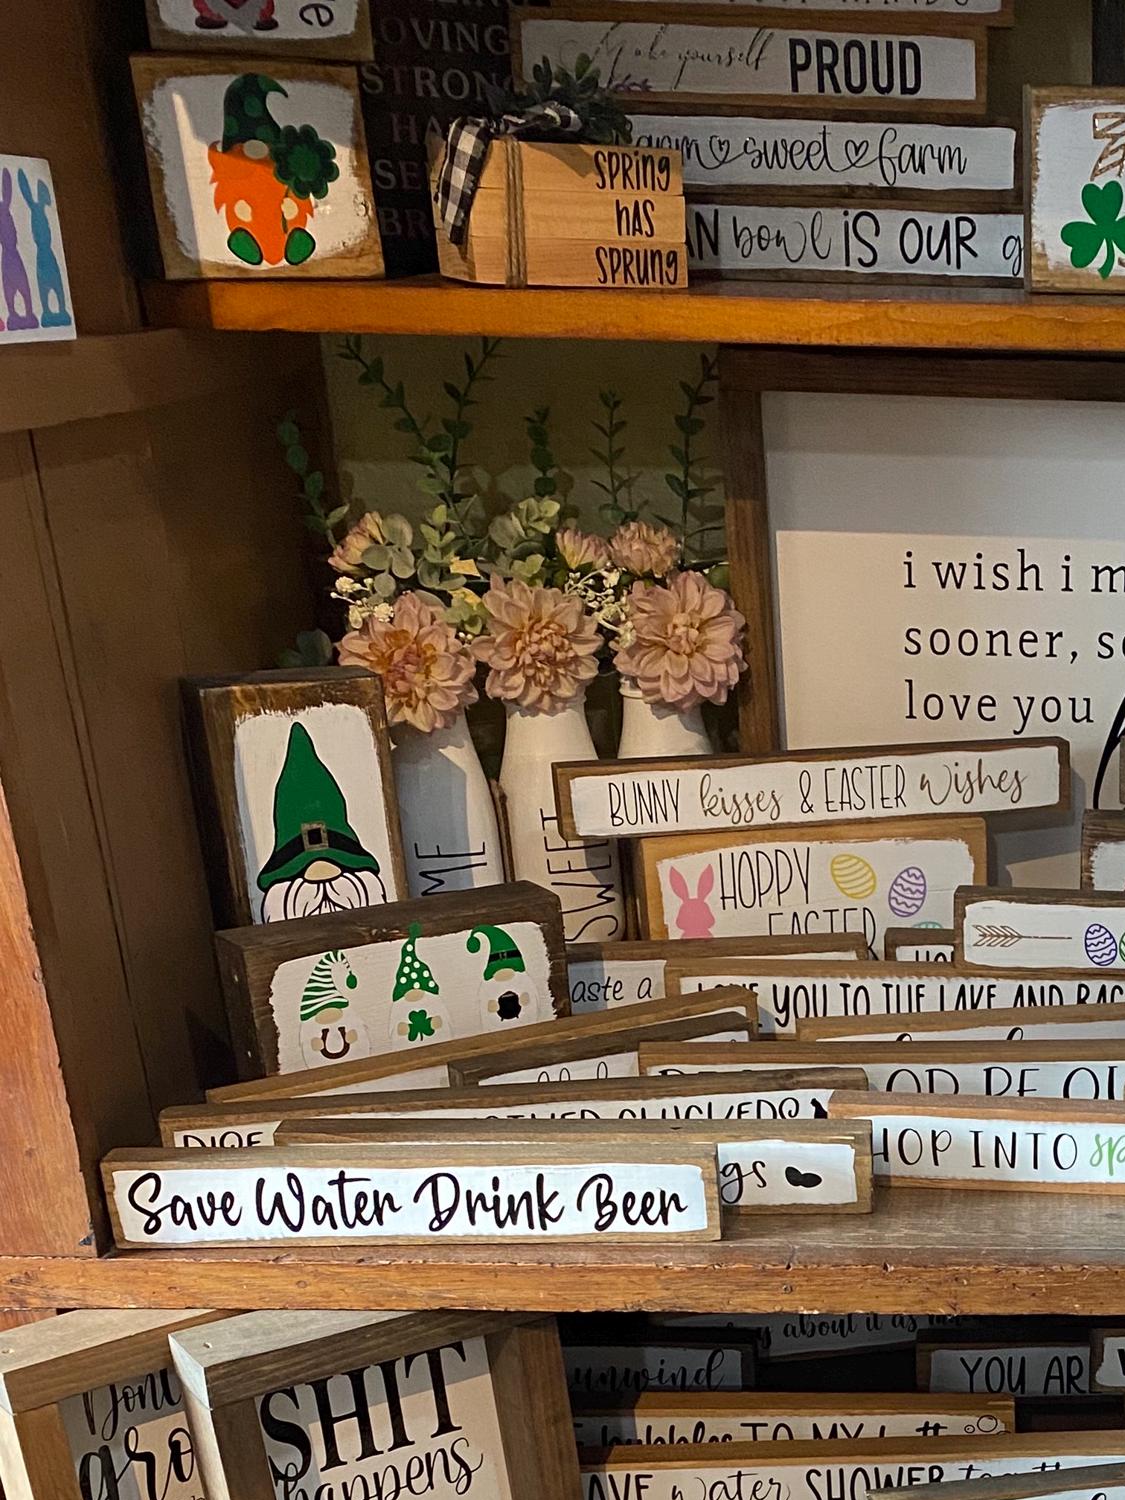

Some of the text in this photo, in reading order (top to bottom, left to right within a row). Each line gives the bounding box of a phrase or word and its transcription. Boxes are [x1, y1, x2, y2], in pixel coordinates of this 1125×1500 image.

[378, 17, 510, 55] OVING
[360, 64, 513, 101] STRON
[789, 38, 921, 95] PROUD
[632, 125, 967, 185] arm sweet farm
[733, 211, 832, 264] bowl
[901, 215, 977, 270] OUR
[903, 551, 917, 589] i
[932, 549, 1044, 593] wish
[1060, 555, 1073, 592] i
[904, 626, 1078, 665] sooner,
[905, 680, 1093, 734] love you
[609, 779, 681, 827] BUNNY
[699, 775, 783, 821] kisses
[798, 771, 815, 814] &
[824, 764, 907, 811] EASTER
[720, 847, 811, 911] HOPPY
[773, 984, 828, 1027] YOU
[840, 984, 870, 1016] TO
[882, 983, 925, 1014] THE
[940, 983, 996, 1012] LAKE
[1013, 983, 1063, 1008] AND
[872, 1128, 1077, 1170] HOP INTO
[127, 1170, 688, 1234] Save Water Drink Beer
[960, 1355, 1092, 1394] YOU AR
[260, 1341, 468, 1484] SHIT
